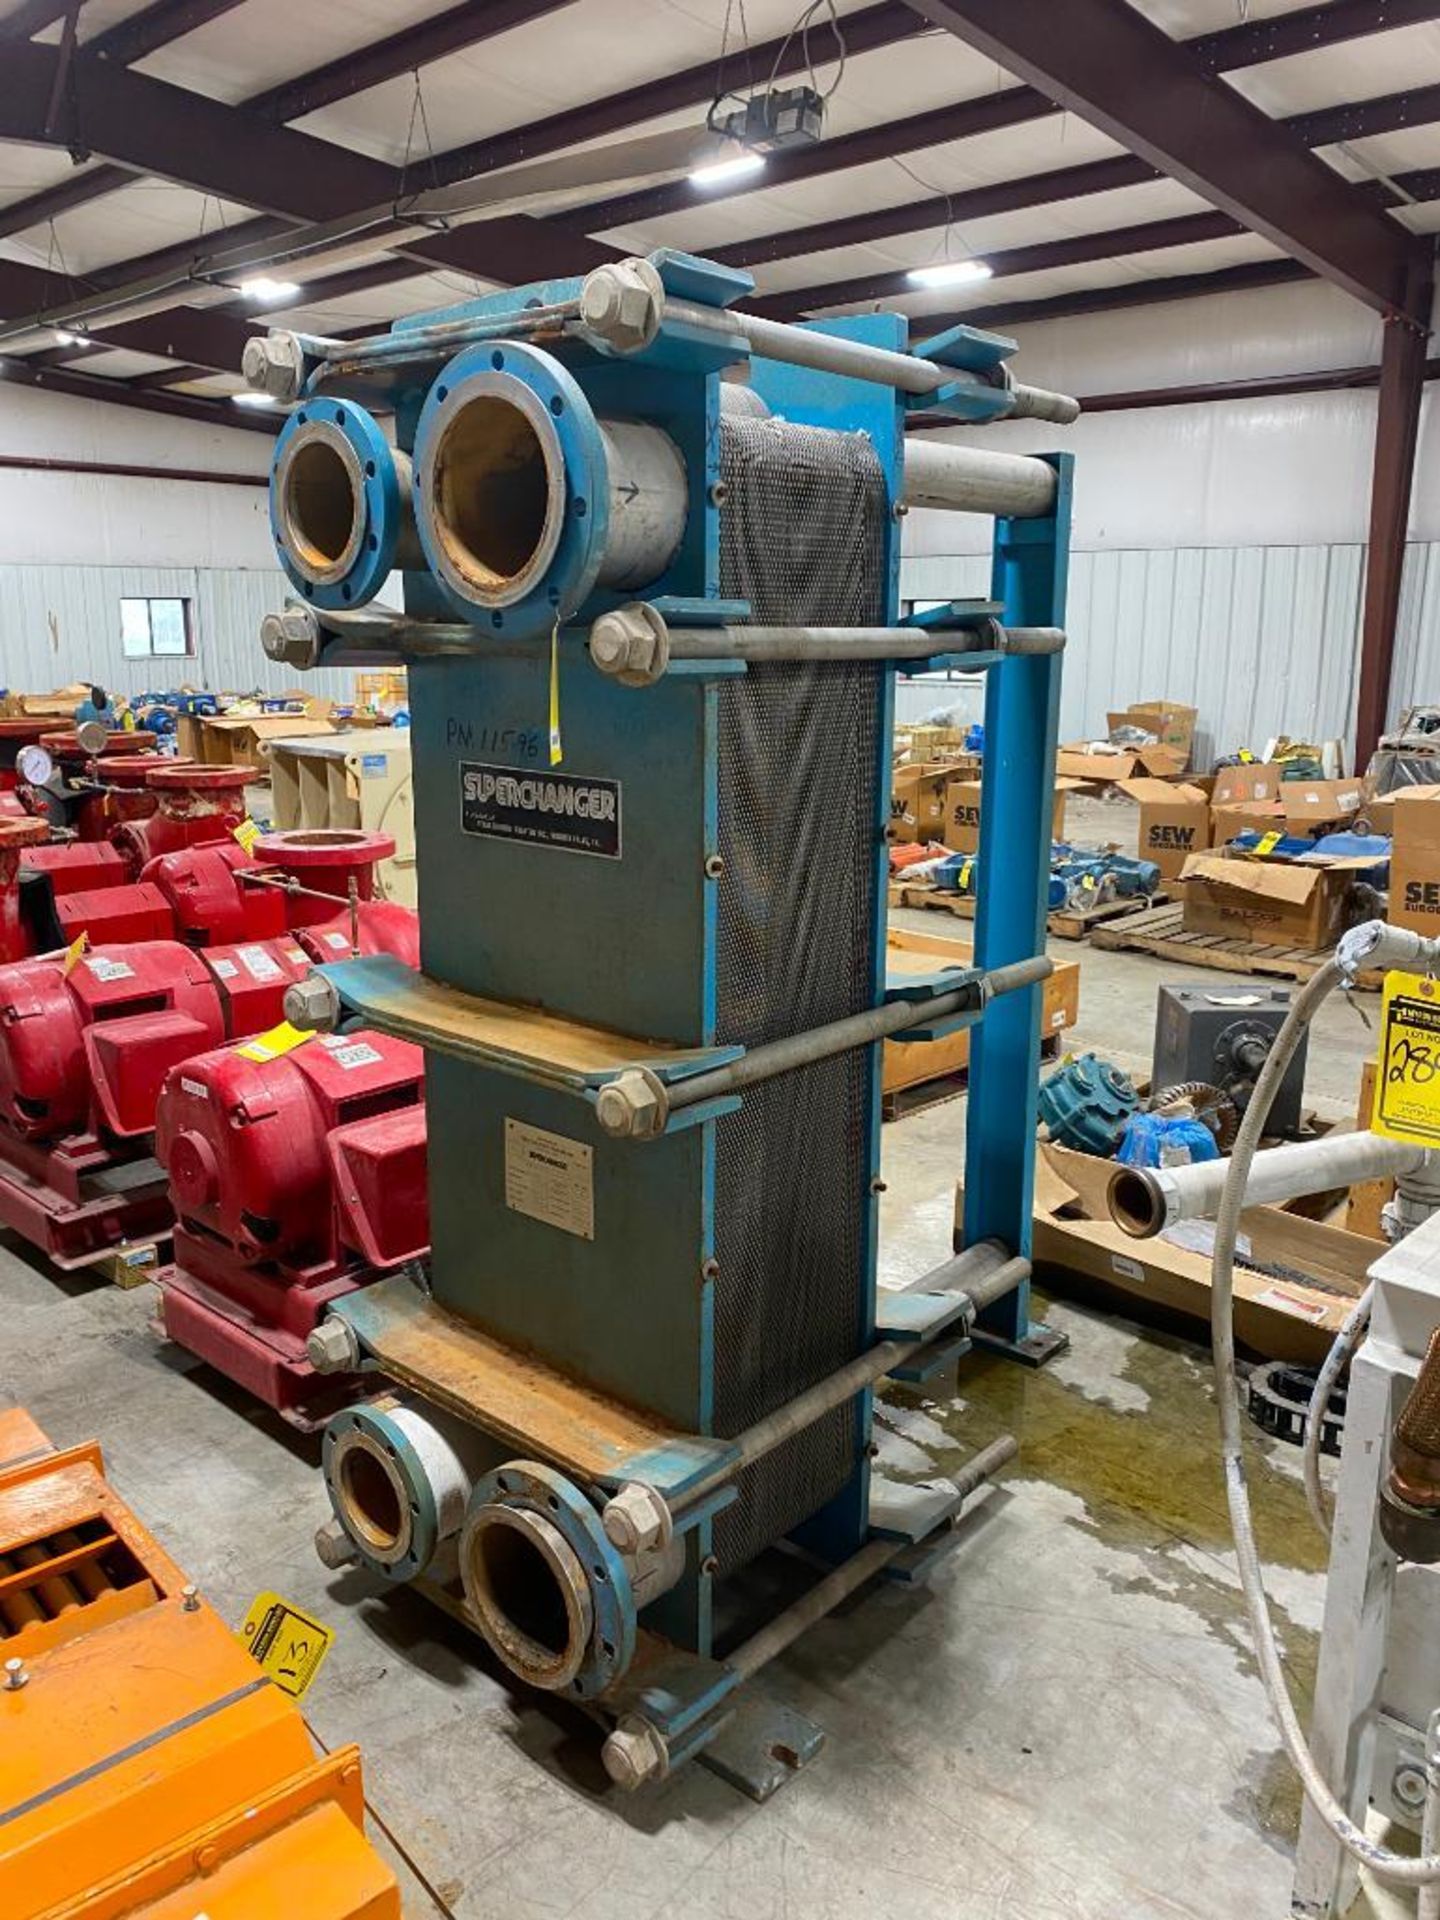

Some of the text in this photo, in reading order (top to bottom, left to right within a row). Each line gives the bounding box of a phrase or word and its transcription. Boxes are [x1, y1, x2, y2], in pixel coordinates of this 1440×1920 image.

[463, 772, 615, 821] SUPERCHANGER
[954, 805, 979, 821] SE
[1150, 825, 1195, 844] SEW
[1406, 882, 1440, 905] SE
